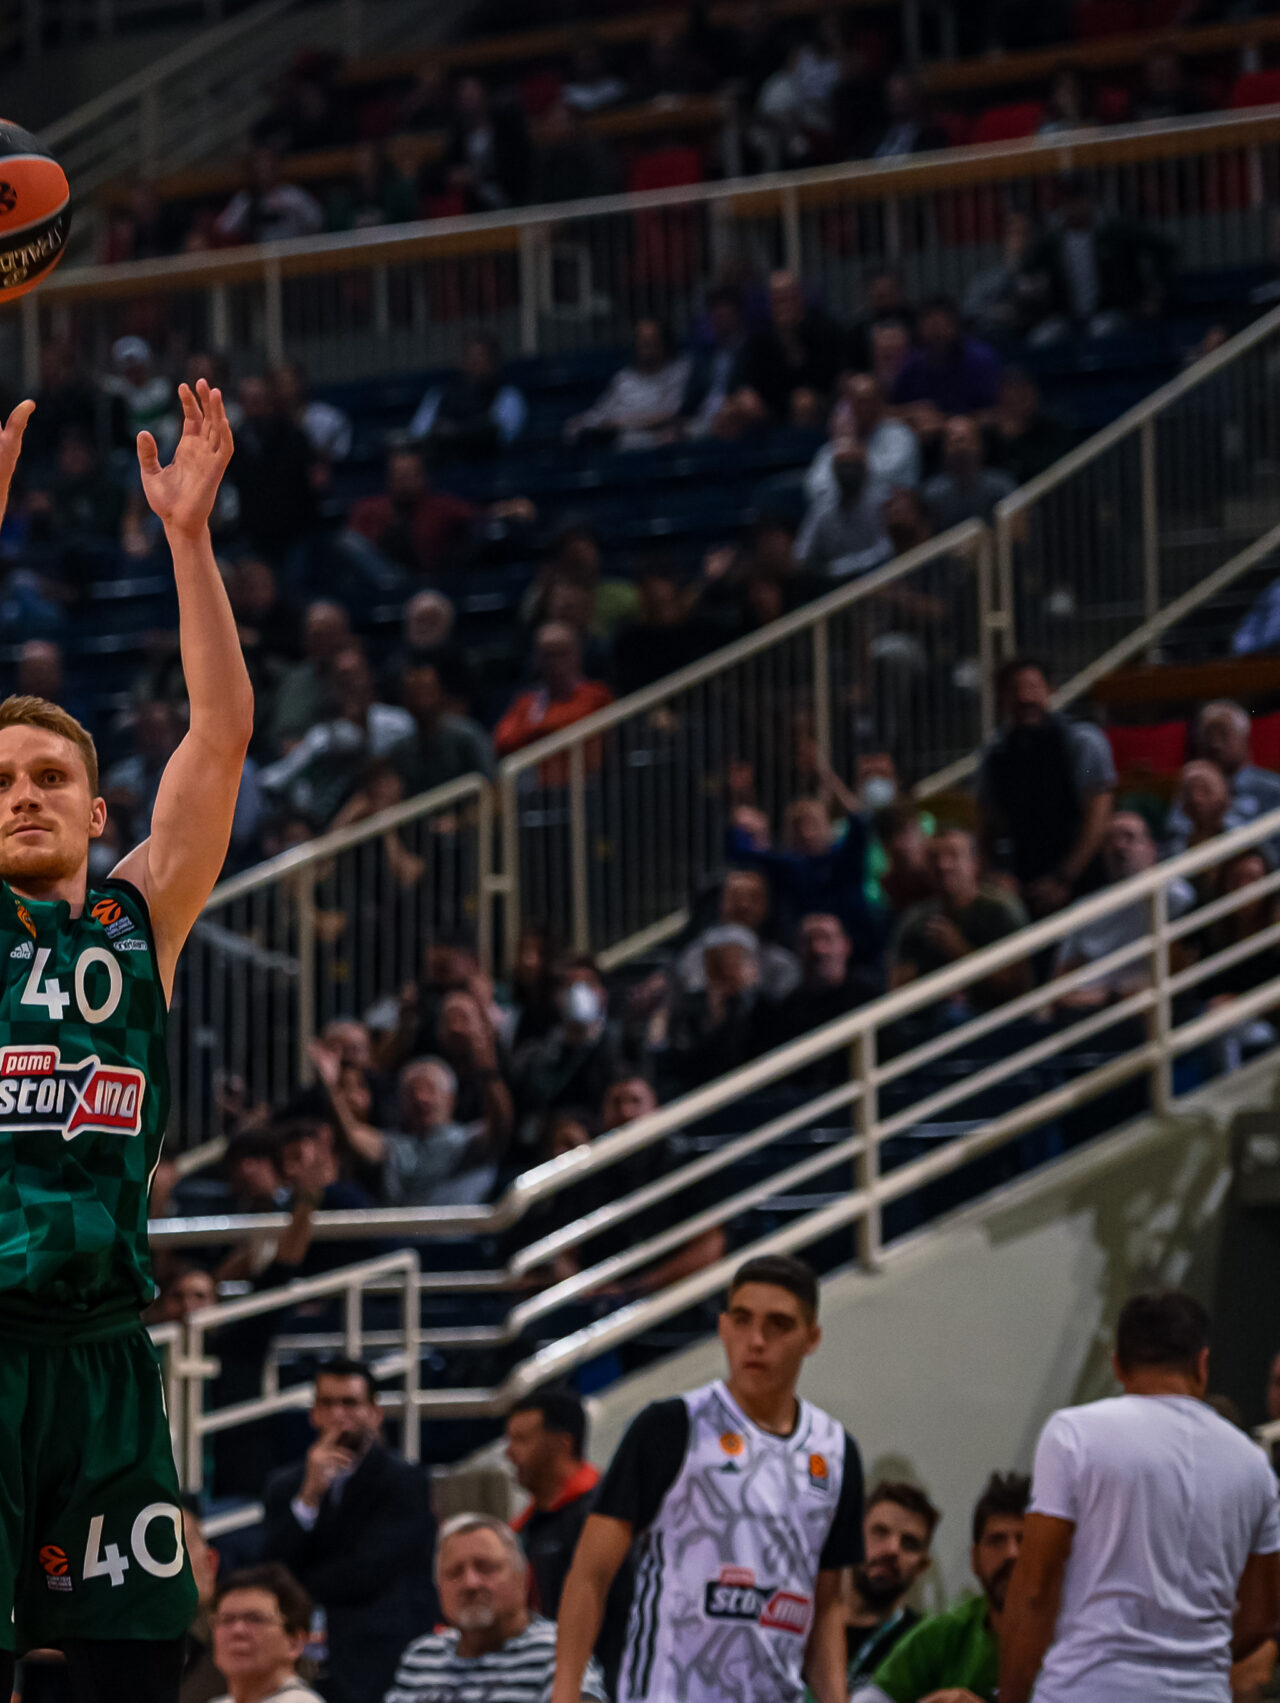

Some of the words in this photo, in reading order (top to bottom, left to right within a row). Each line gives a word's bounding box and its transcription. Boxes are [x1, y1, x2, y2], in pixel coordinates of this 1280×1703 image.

[21, 947, 122, 1024] 40
[5, 1055, 52, 1074] pame
[83, 1502, 183, 1587] 40
